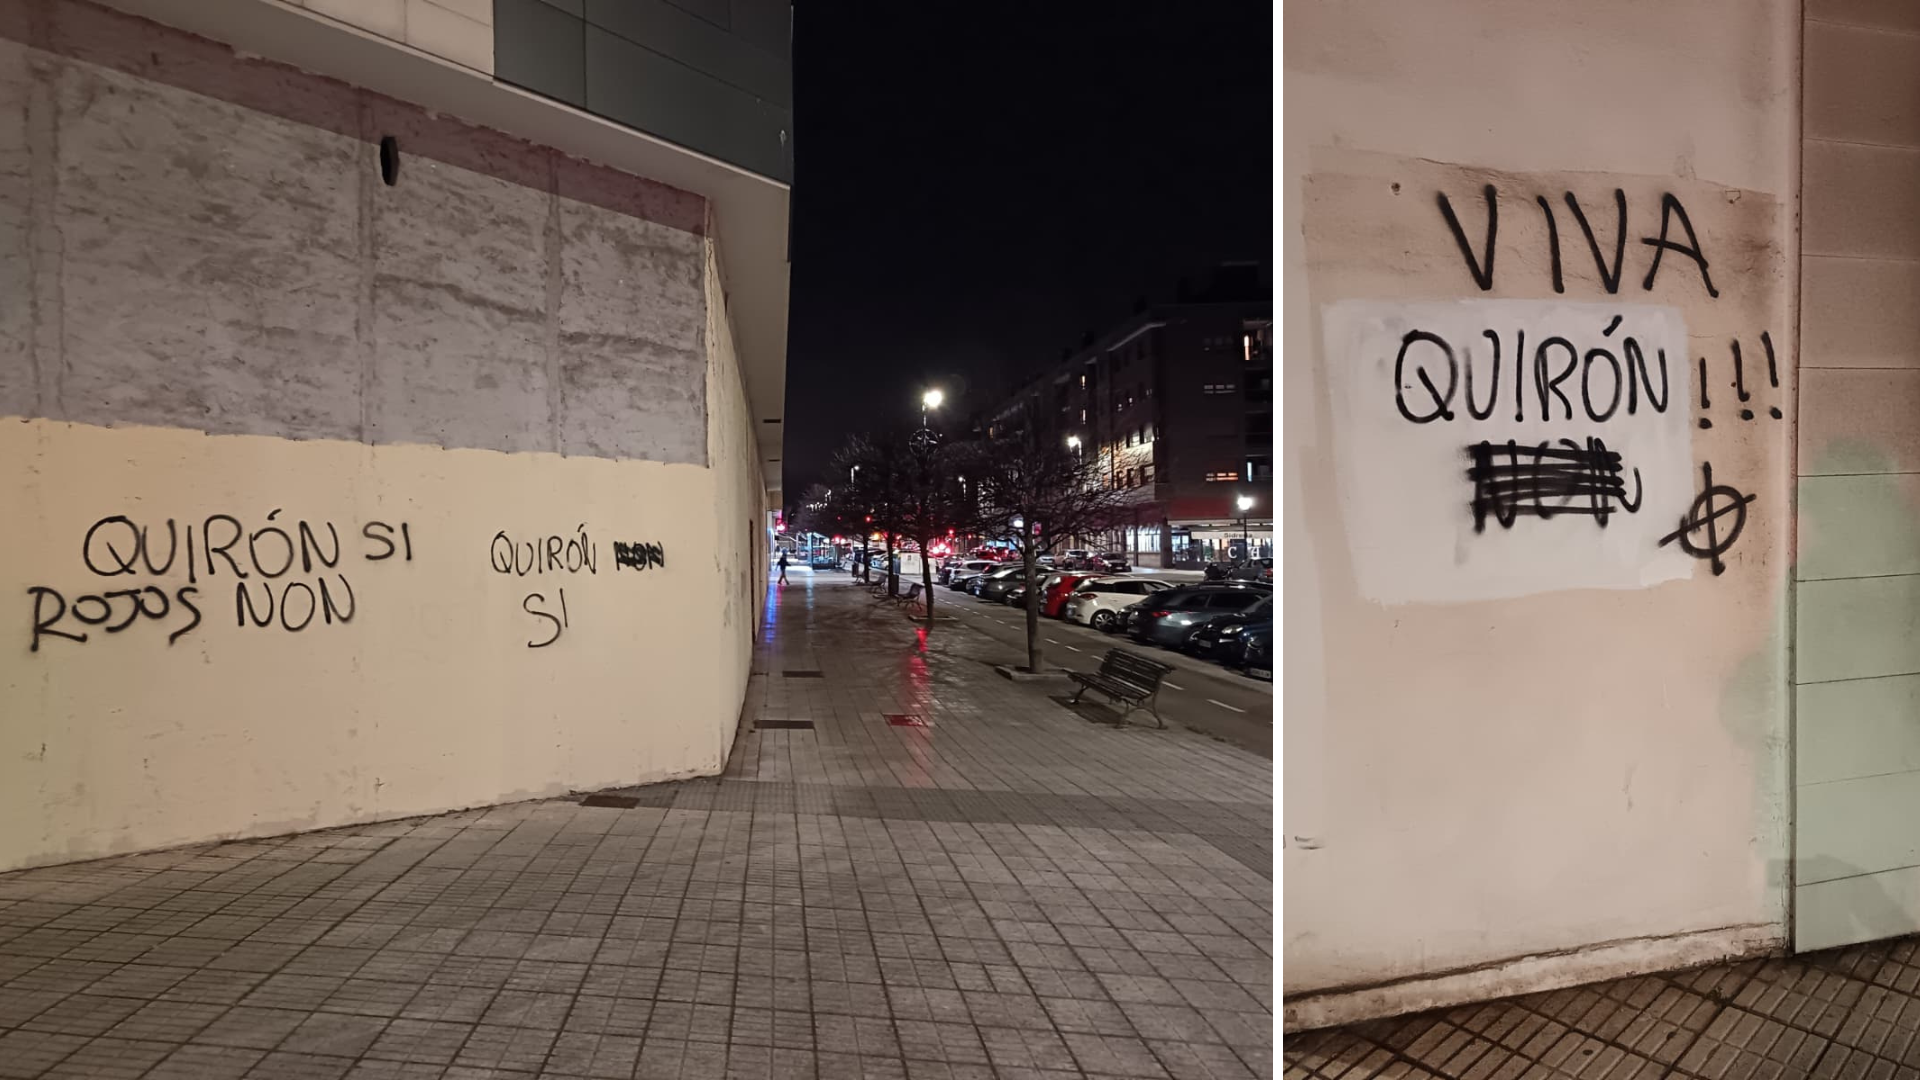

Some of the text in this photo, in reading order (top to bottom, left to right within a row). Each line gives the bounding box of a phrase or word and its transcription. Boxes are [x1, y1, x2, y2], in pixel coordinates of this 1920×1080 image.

[1436, 184, 1719, 298] VIVA
[83, 509, 413, 584] QUIRÓN SI
[491, 524, 596, 576] QUIRÓN
[27, 574, 355, 652] ROJOS NON
[523, 588, 568, 648] SI
